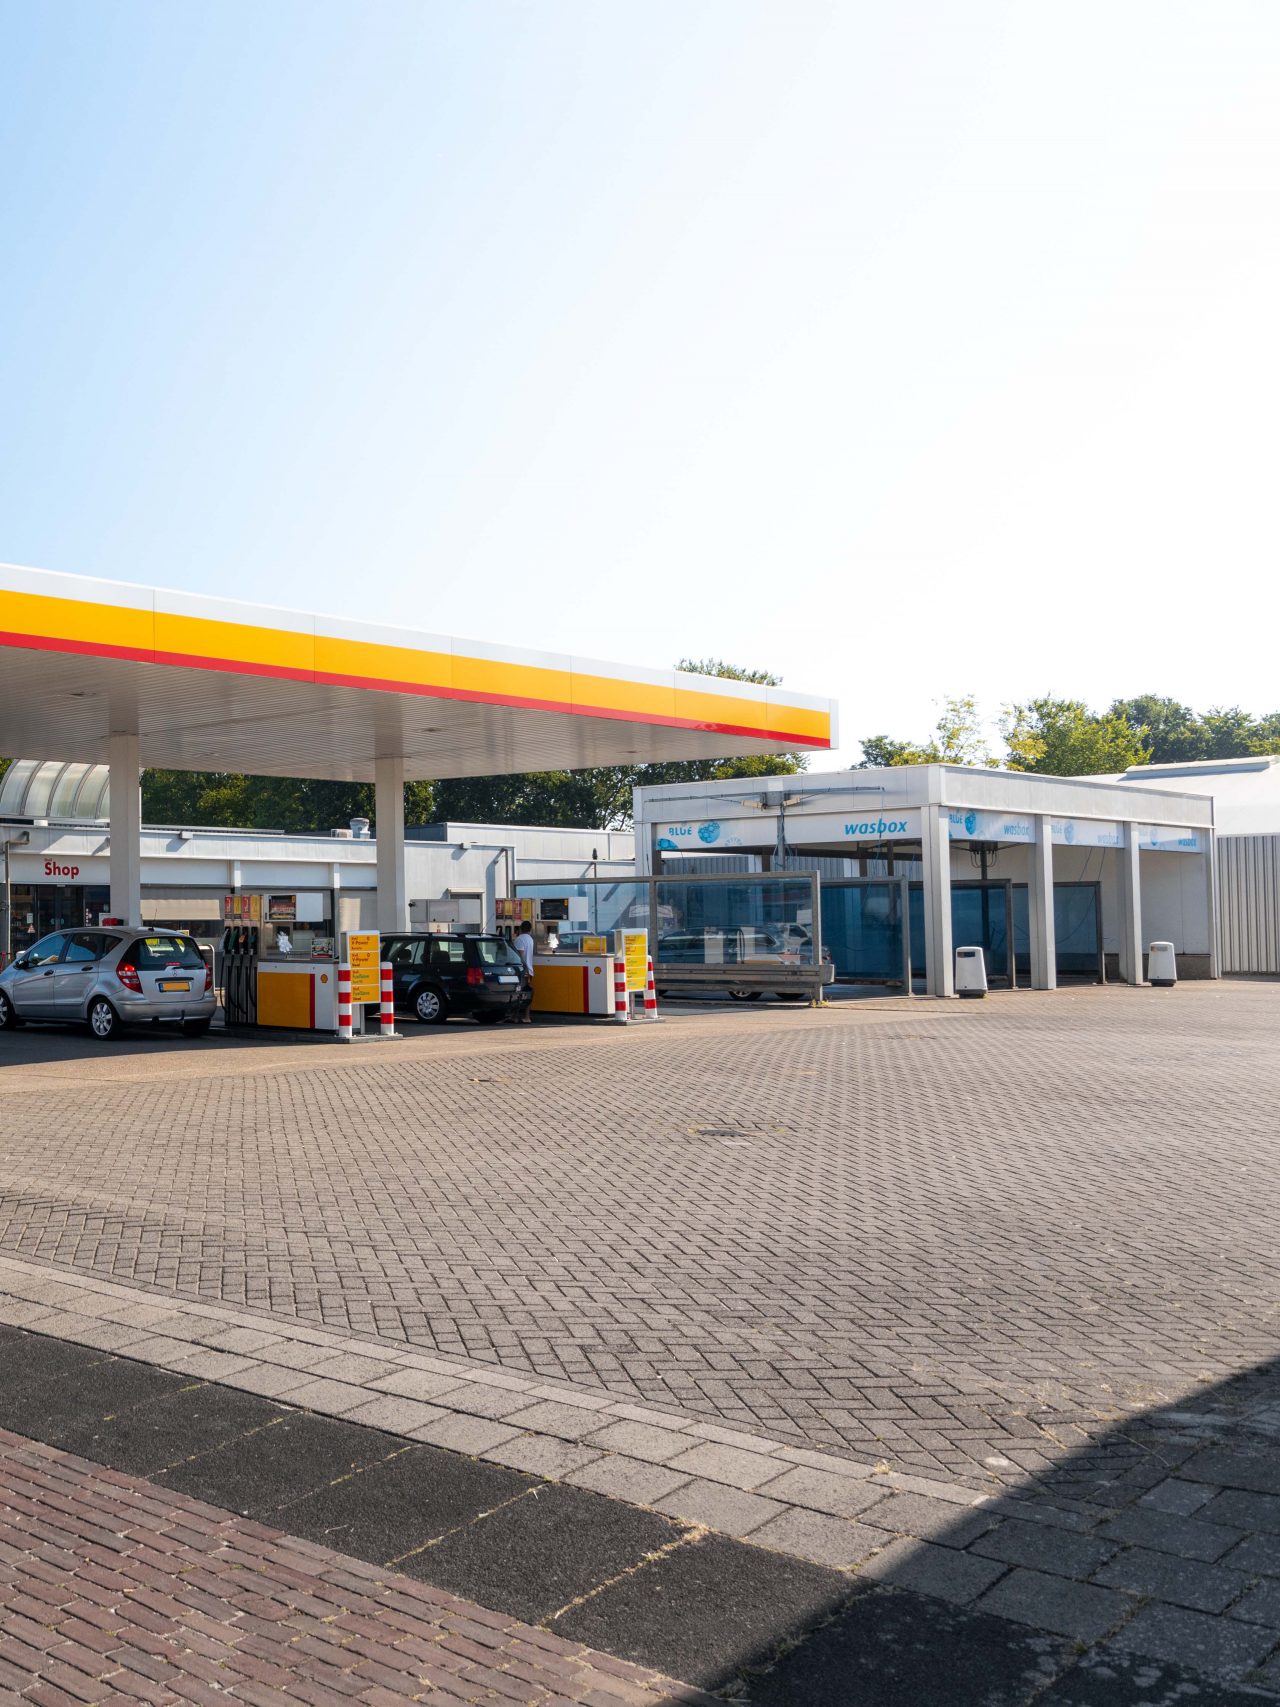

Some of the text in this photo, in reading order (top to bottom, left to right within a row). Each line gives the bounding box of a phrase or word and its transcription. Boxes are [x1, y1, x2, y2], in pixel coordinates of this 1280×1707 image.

[668, 827, 692, 836] BLUE
[844, 818, 908, 835] wasbox
[44, 862, 79, 879] Shop
